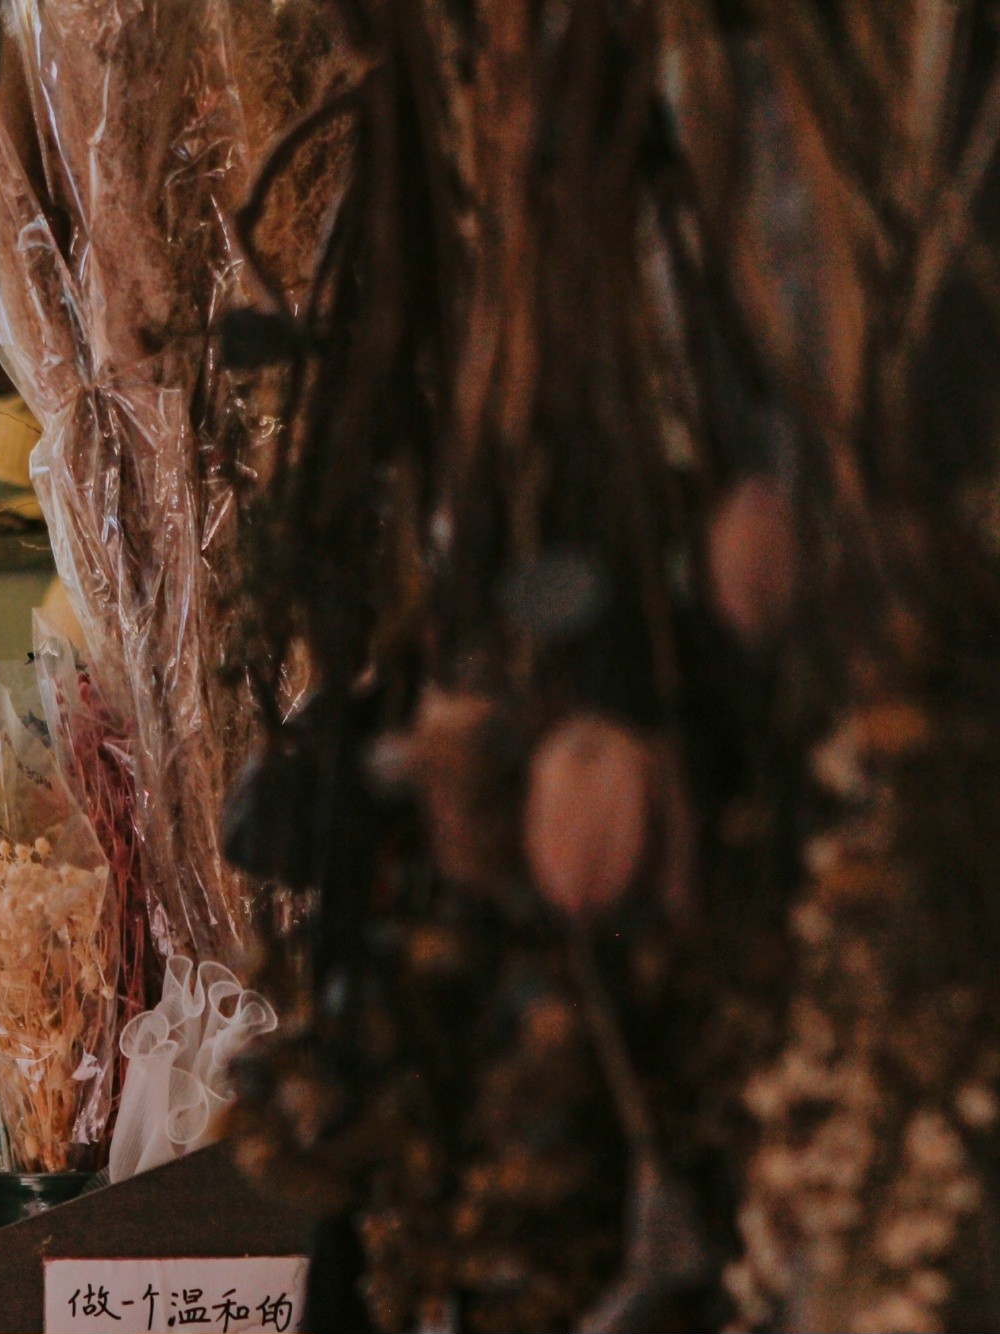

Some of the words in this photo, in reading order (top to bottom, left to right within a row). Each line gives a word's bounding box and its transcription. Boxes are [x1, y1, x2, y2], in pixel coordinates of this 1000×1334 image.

[68, 1283, 293, 1334] 做一个温和的
